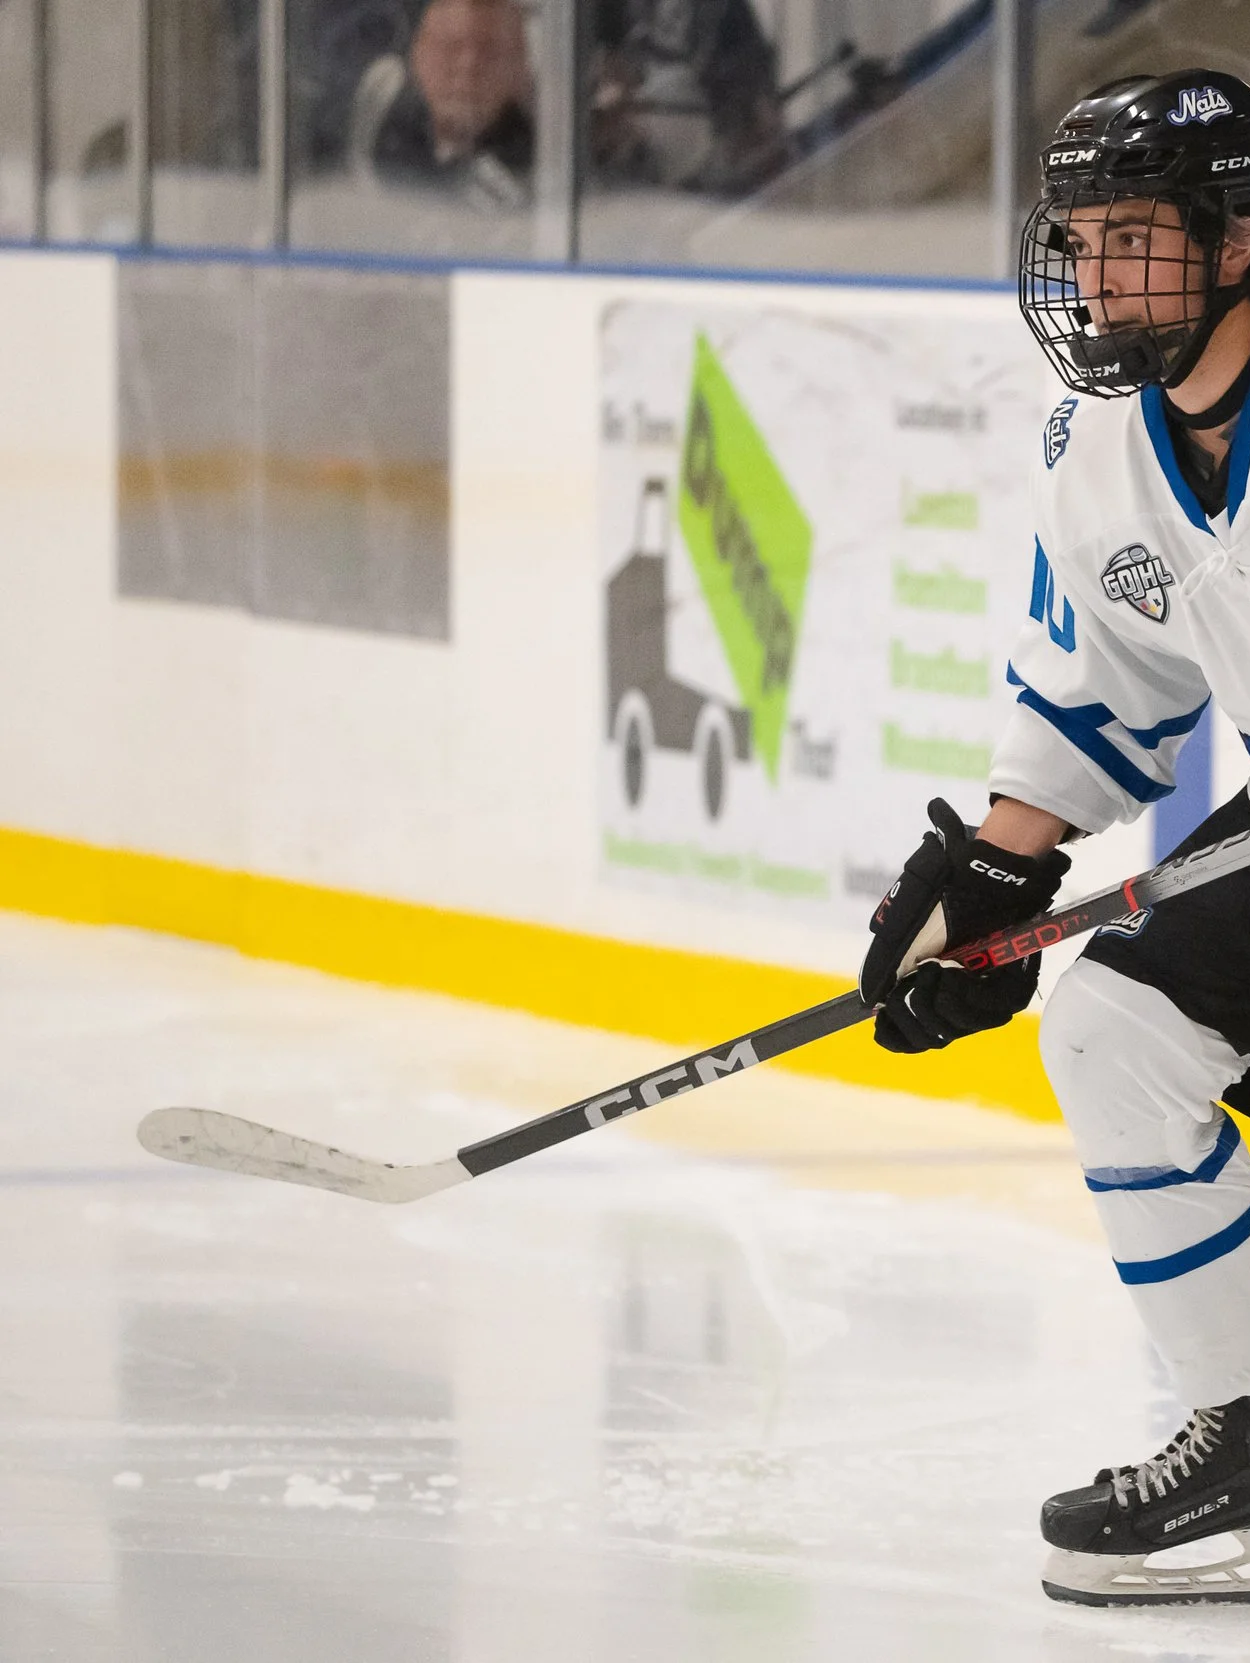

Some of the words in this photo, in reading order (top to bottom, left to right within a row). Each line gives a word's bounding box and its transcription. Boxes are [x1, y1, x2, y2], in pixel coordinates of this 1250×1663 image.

[1171, 88, 1232, 124] Nats
[1048, 149, 1097, 165] CCM
[1102, 557, 1173, 600] GOJHL
[969, 859, 1028, 886] CCM
[584, 1039, 759, 1129] CCM
[1164, 1495, 1230, 1533] BAUER
